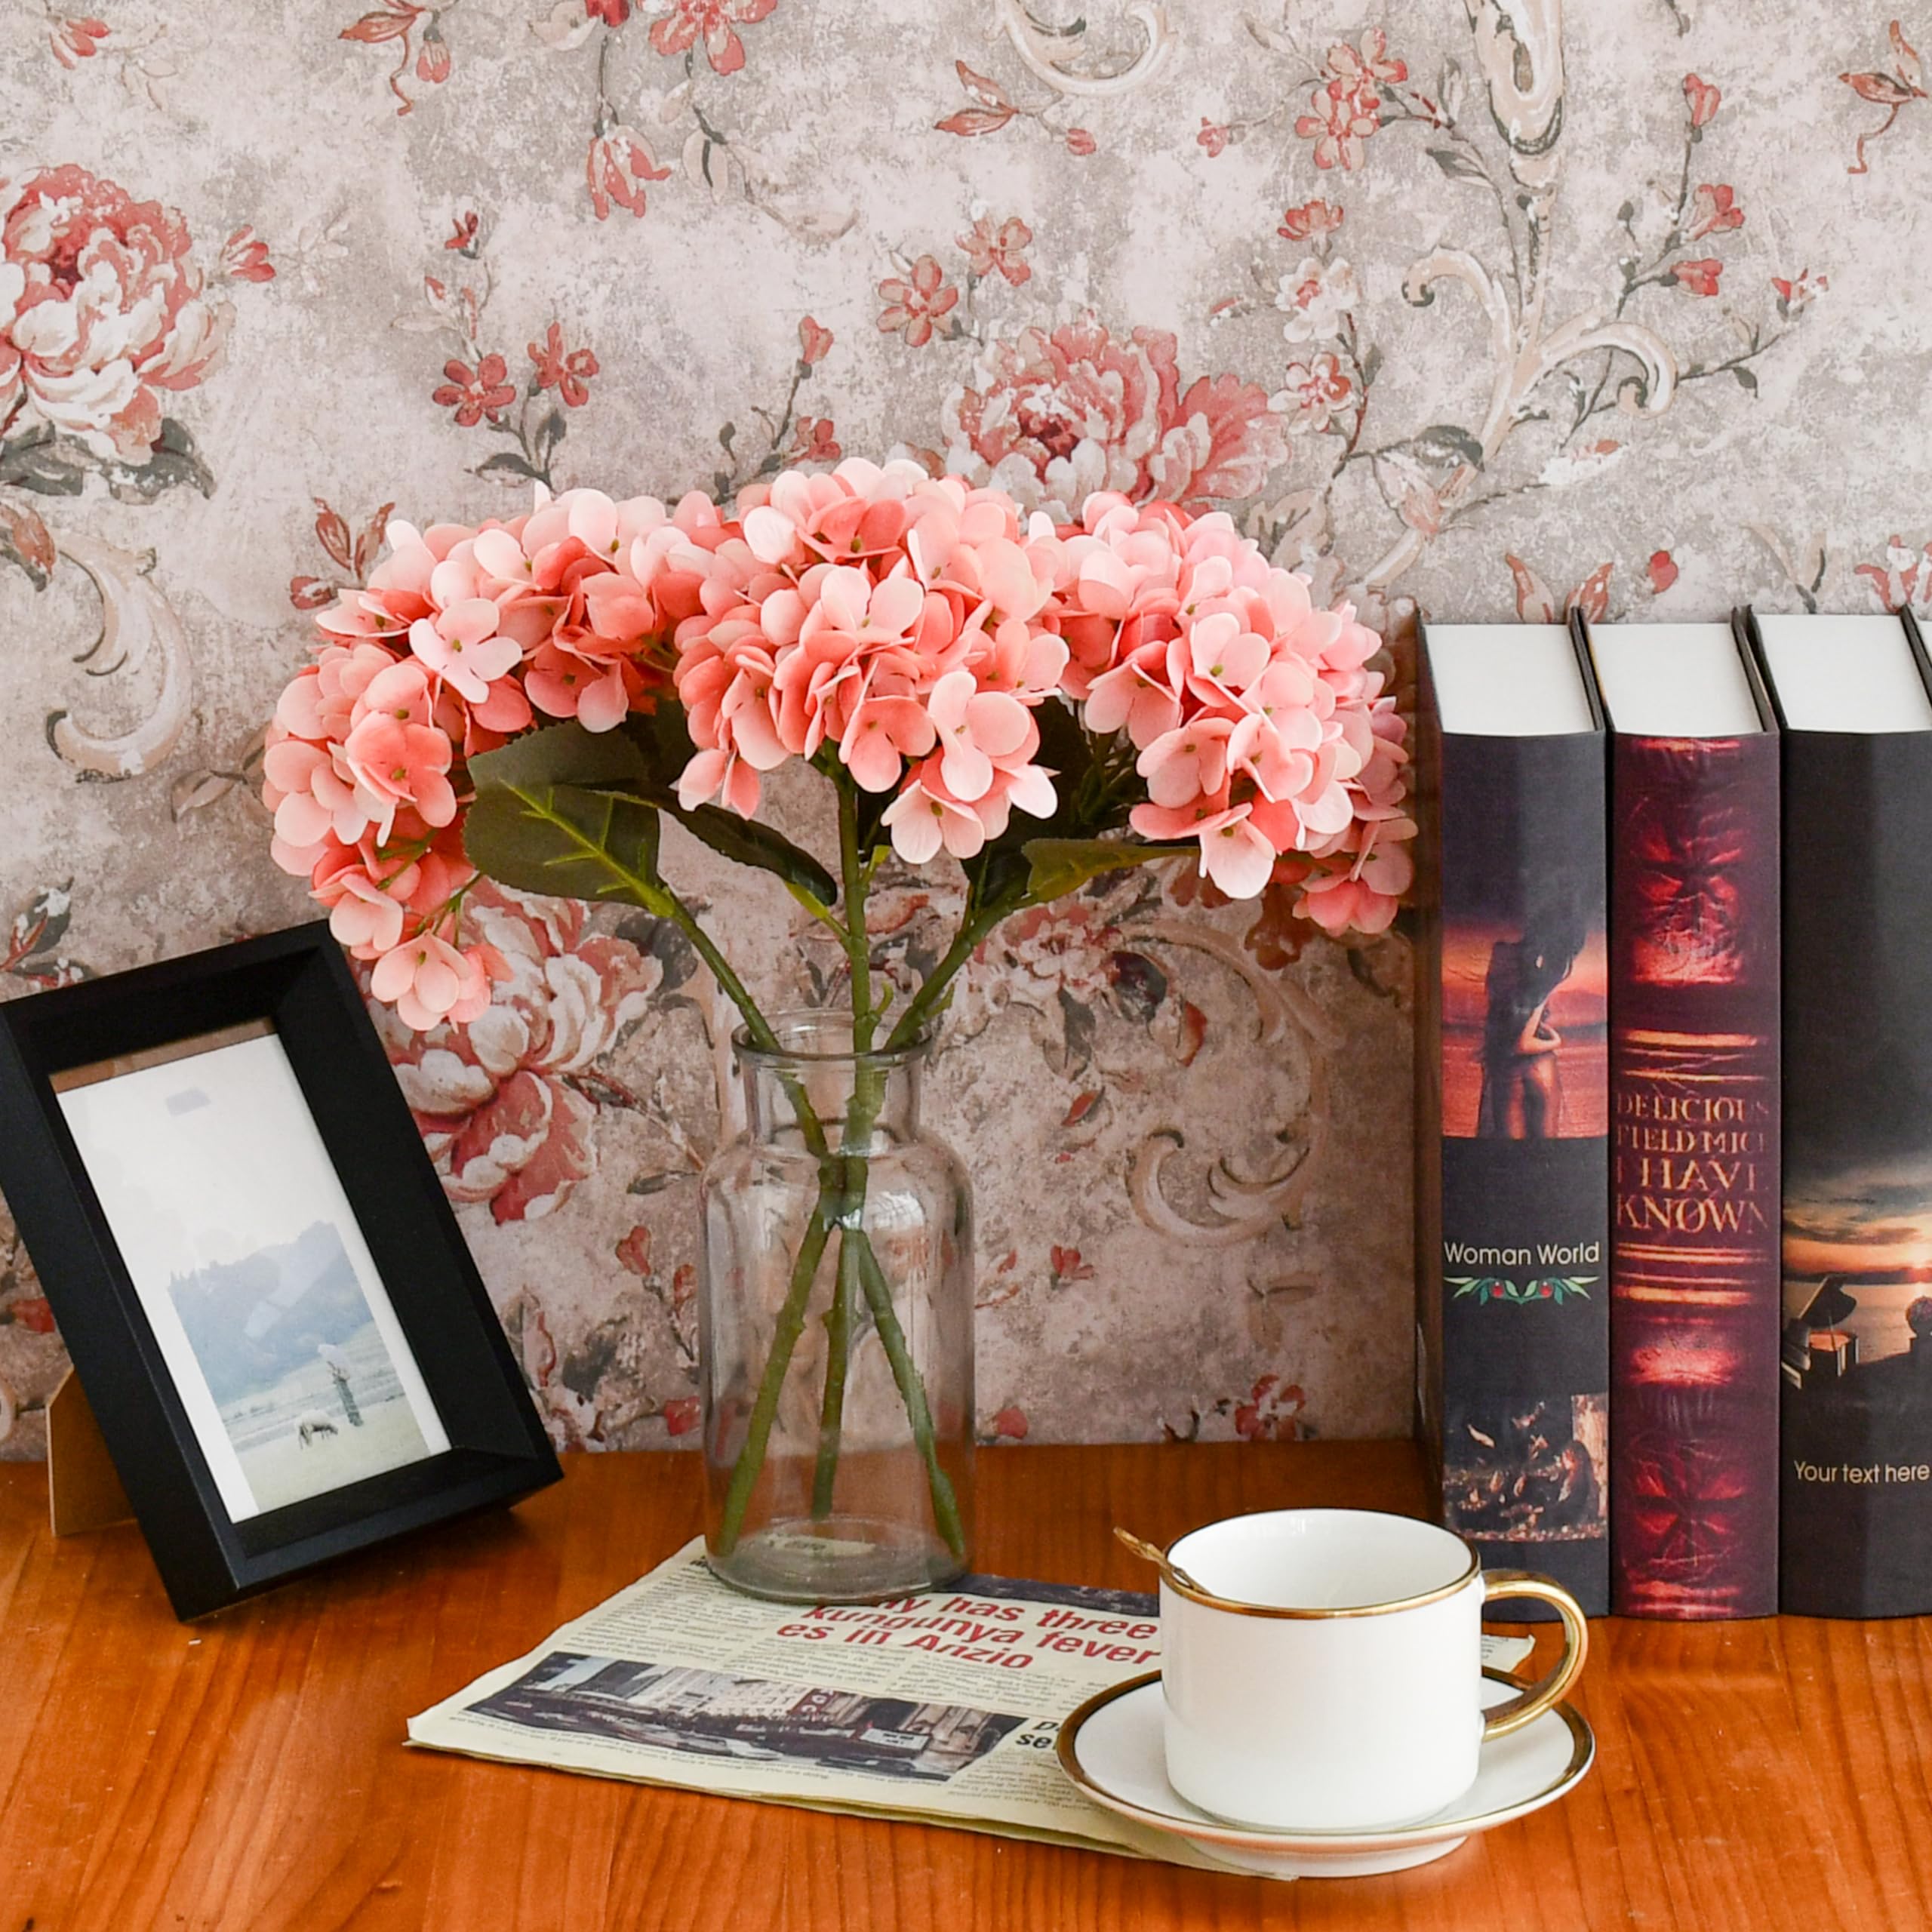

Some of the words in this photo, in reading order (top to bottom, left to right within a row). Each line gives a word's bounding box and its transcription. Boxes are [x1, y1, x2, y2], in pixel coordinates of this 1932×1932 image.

[1444, 1241, 1531, 1265] Woman
[1537, 1241, 1600, 1265] World
[1794, 1460, 1837, 1482] Your
[1842, 1463, 1880, 1484] text
[1884, 1463, 1930, 1482] here
[800, 1604, 1025, 1644] kungunya
[1036, 1631, 1161, 1664] fever
[938, 1595, 1025, 1620] has
[1036, 1608, 1158, 1639] three
[777, 1623, 835, 1640] es
[843, 1625, 893, 1644] in
[900, 1634, 1033, 1669] Anzio
